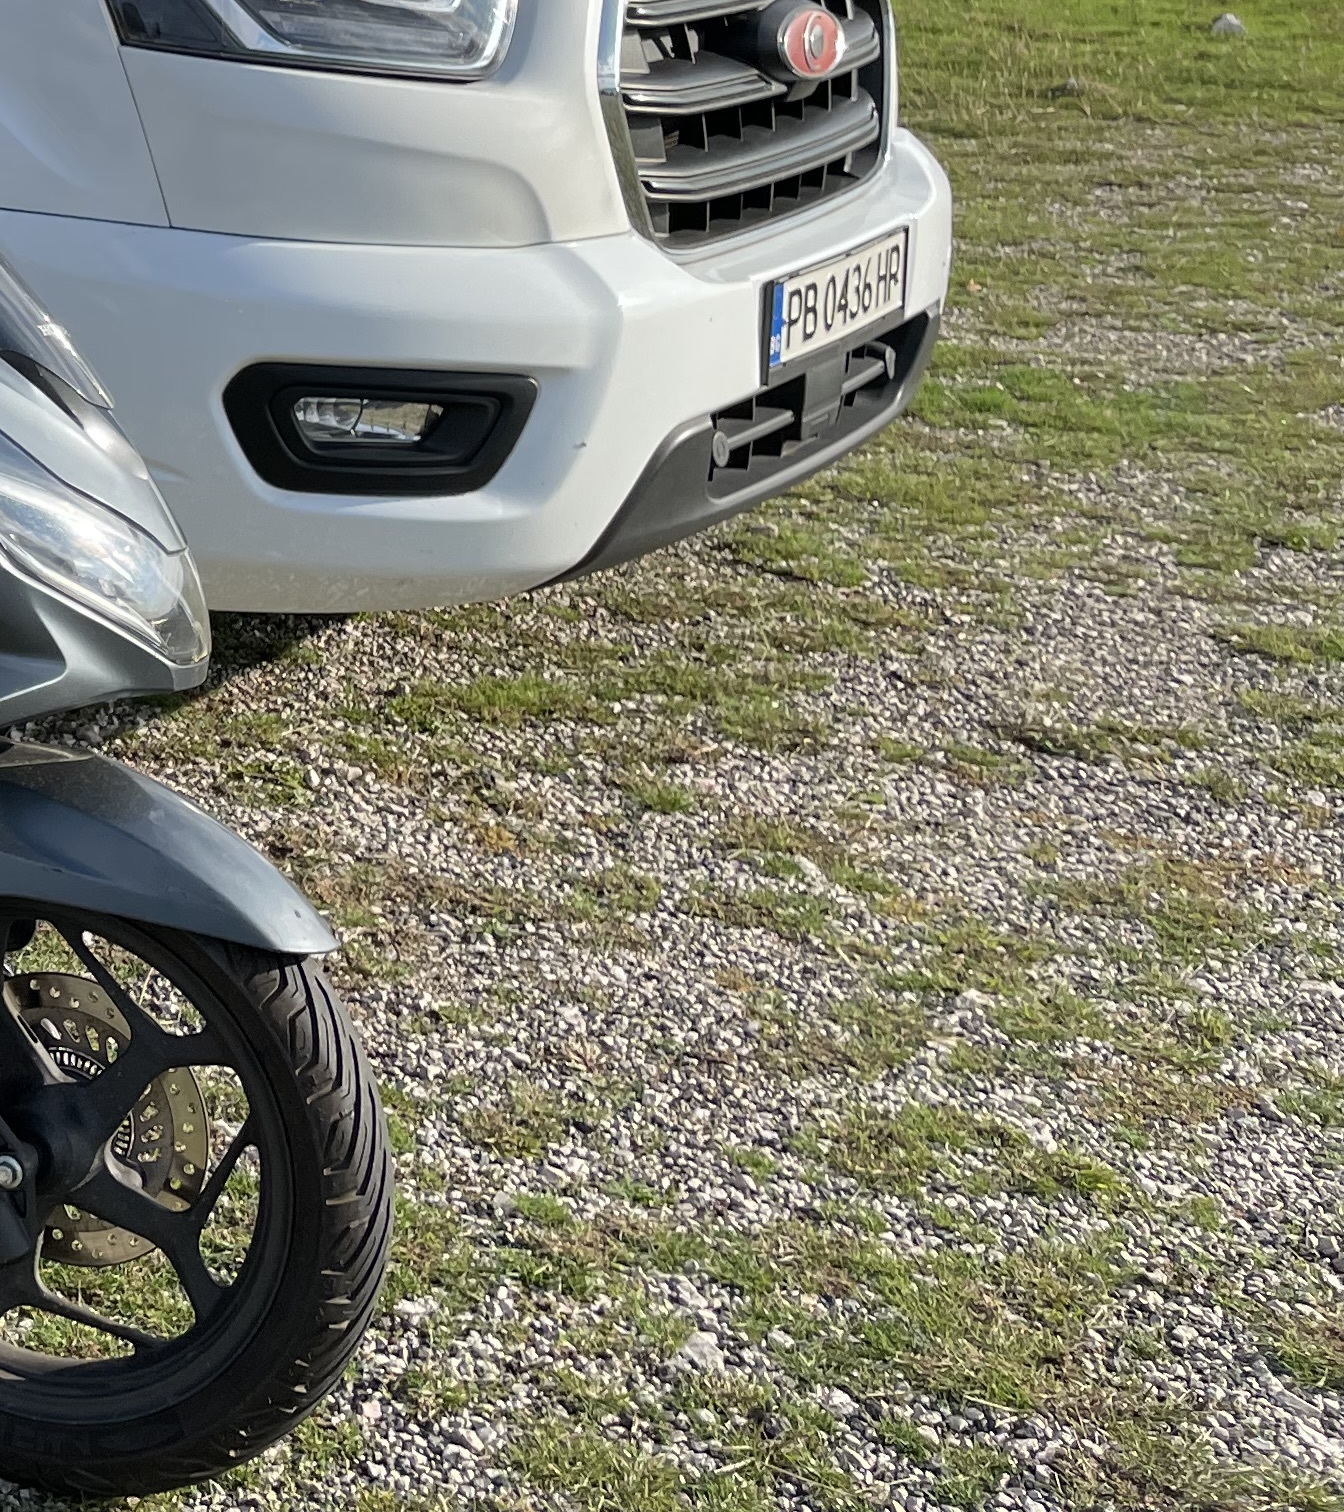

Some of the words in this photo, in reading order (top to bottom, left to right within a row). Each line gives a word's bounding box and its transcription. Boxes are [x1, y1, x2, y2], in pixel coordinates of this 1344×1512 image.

[785, 282, 818, 351] PB
[824, 256, 873, 332] 0436
[875, 244, 901, 308] HR
